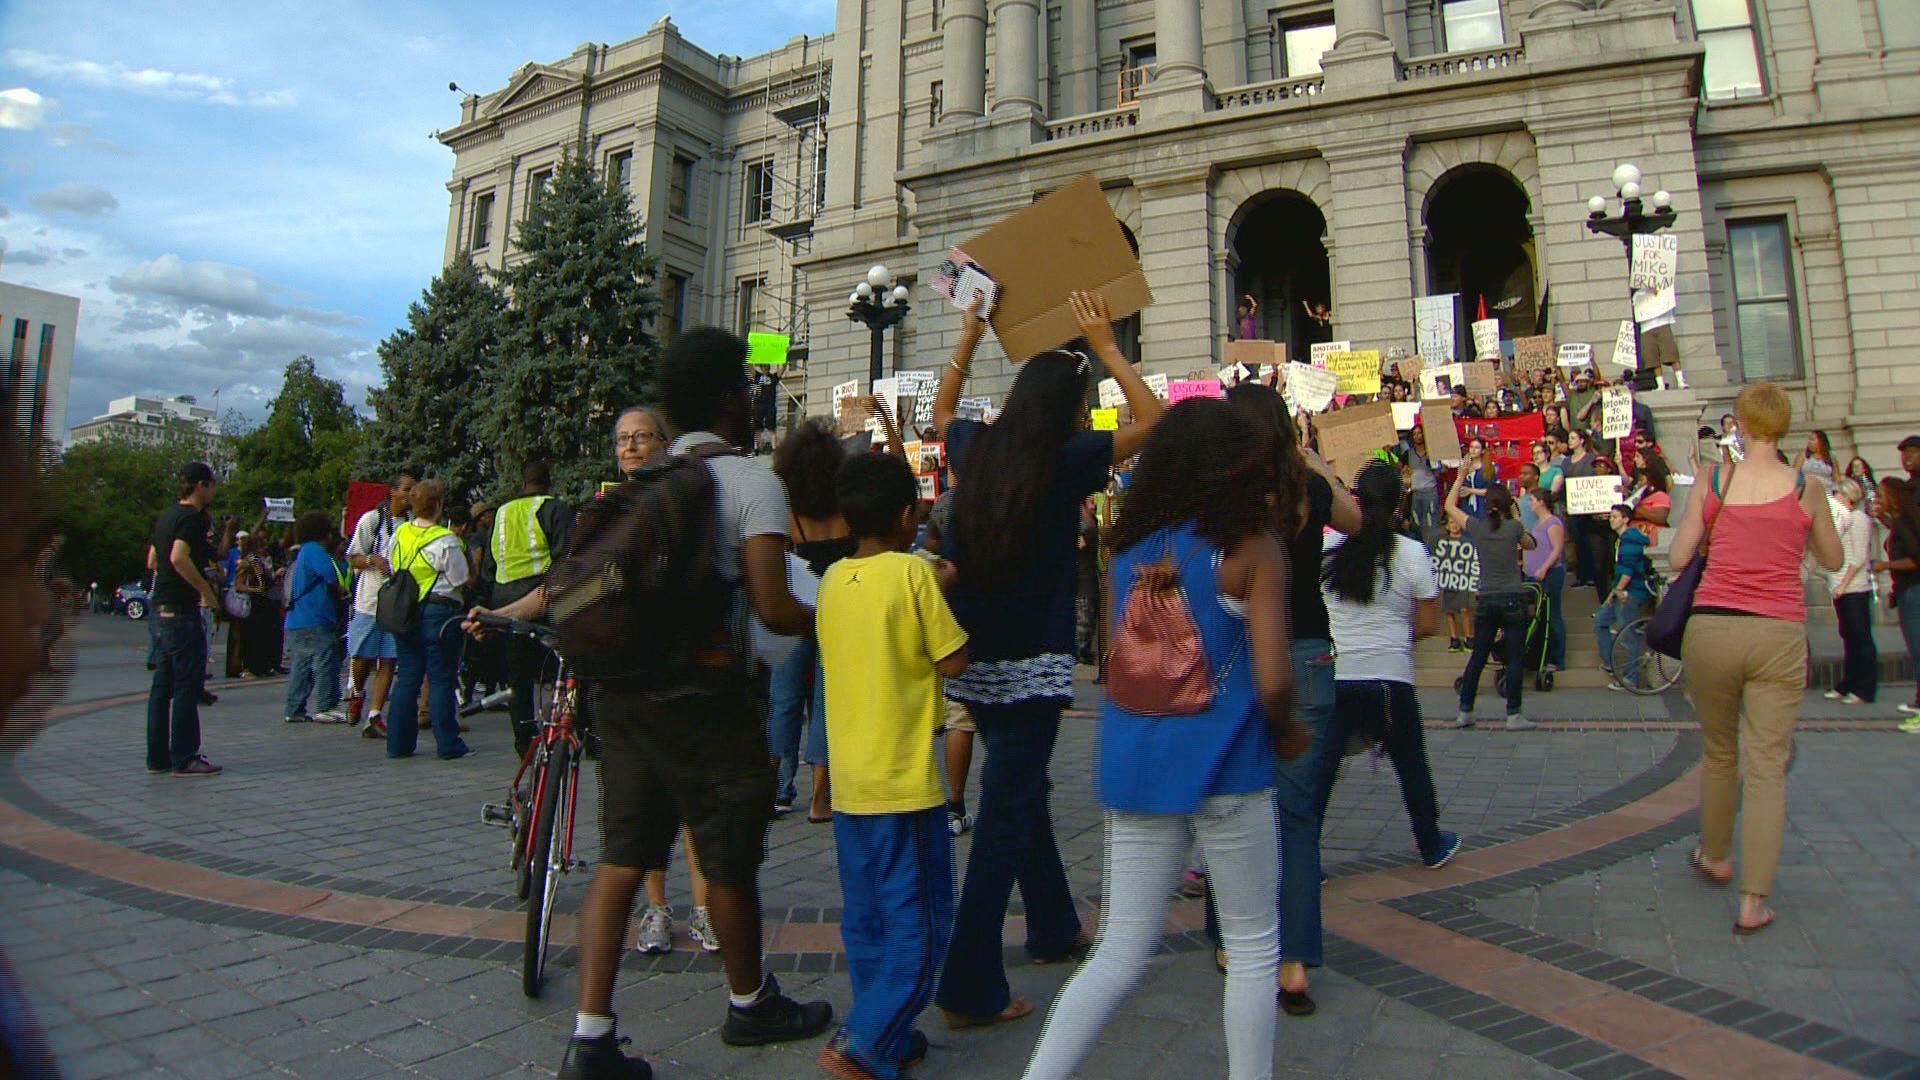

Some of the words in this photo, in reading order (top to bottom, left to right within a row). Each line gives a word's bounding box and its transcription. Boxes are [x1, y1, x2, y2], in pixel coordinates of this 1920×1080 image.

[1643, 250, 1661, 260] FOR
[1633, 274, 1672, 290] BROWN
[1173, 383, 1208, 394] OSCAR
[1611, 407, 1621, 415] TO
[1607, 414, 1628, 424] EACH
[1575, 479, 1604, 491] LOVE
[1430, 555, 1480, 575] RACIS
[1435, 572, 1480, 592] URDE
